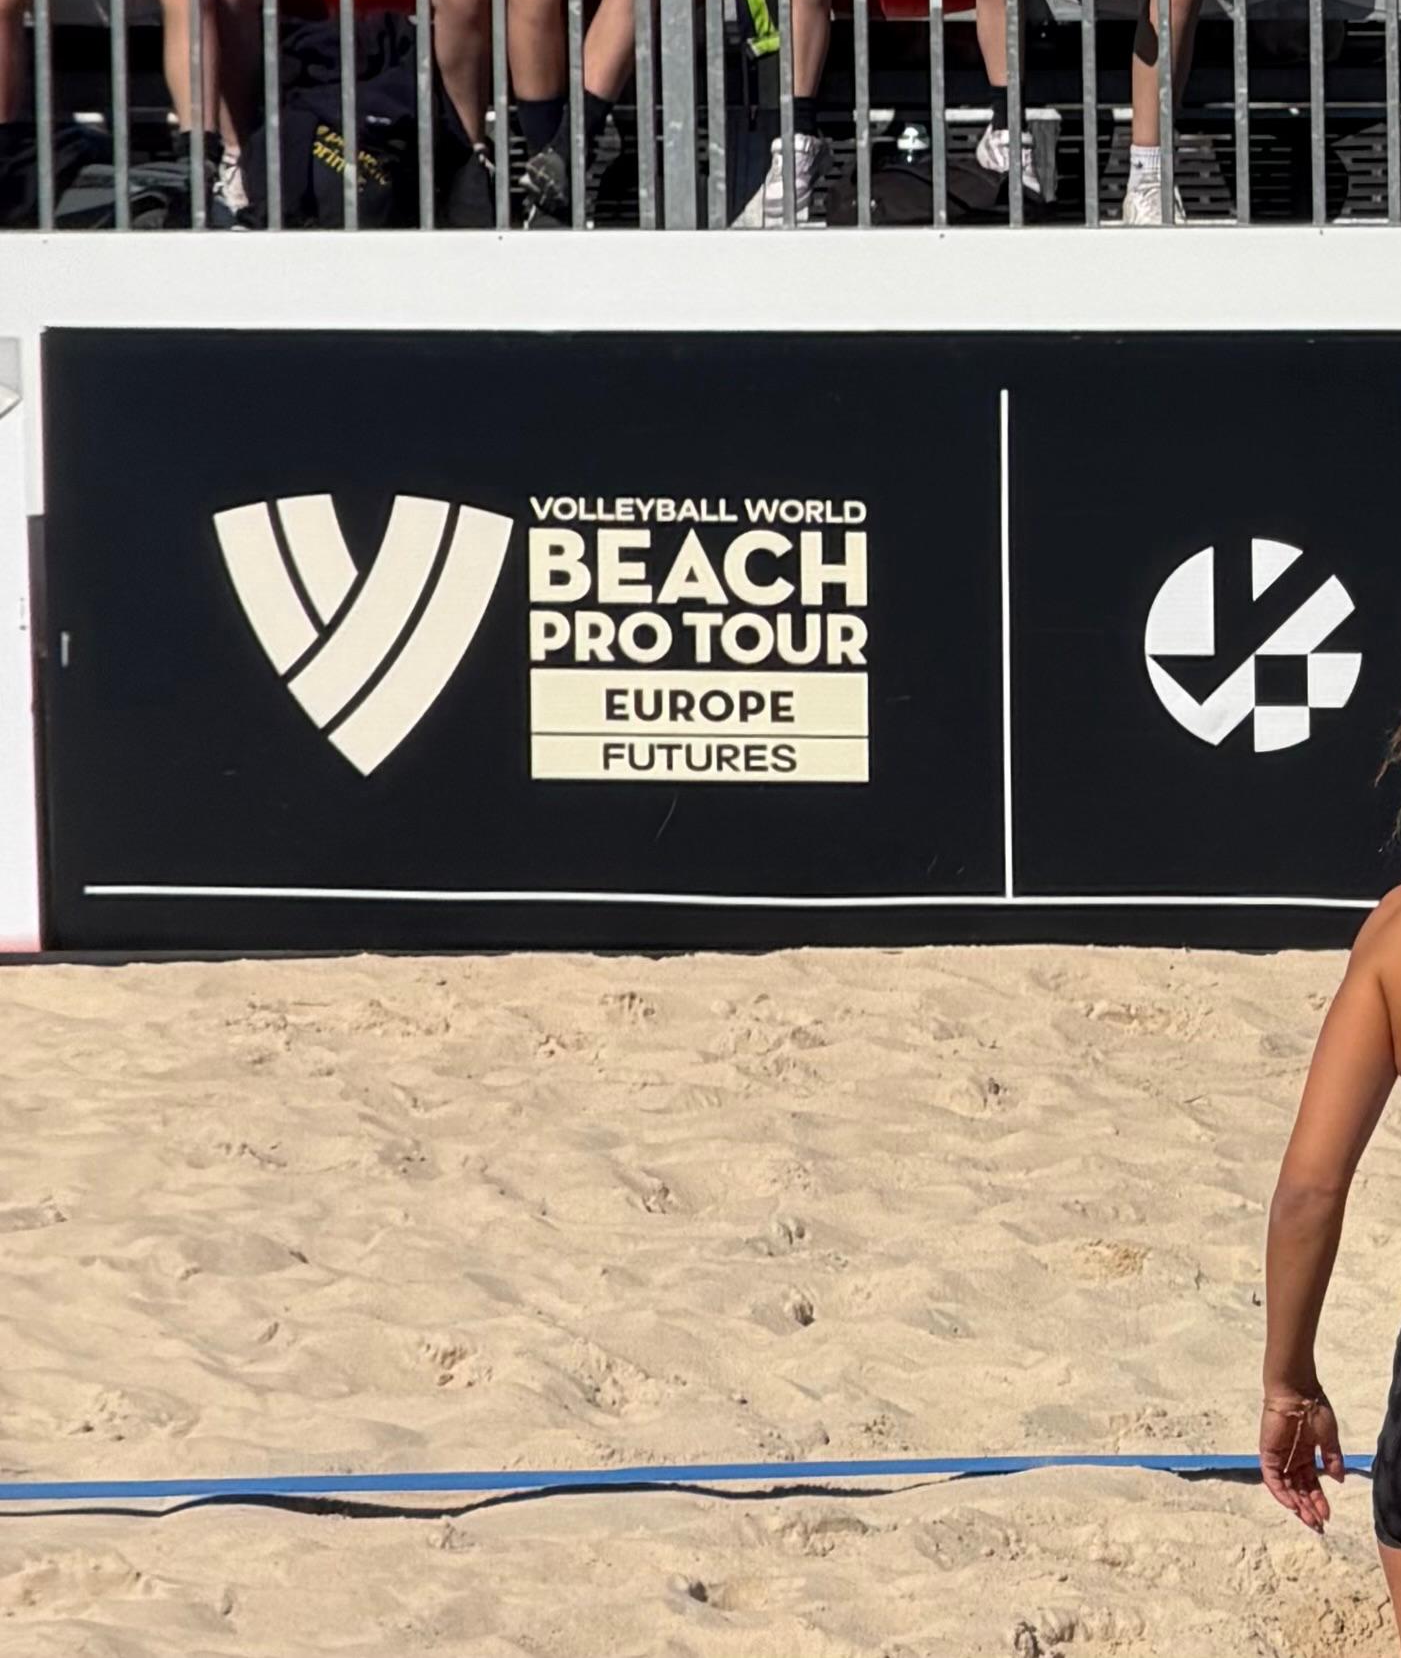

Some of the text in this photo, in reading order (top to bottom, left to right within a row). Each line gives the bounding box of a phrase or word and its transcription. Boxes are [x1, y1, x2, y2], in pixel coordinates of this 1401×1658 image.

[529, 497, 867, 523] VOLLEYBALL WORLD
[529, 527, 868, 606] BEACH
[529, 610, 868, 665] PRO TOUR
[605, 689, 795, 723] EUROPE
[603, 743, 798, 773] FUTURES
